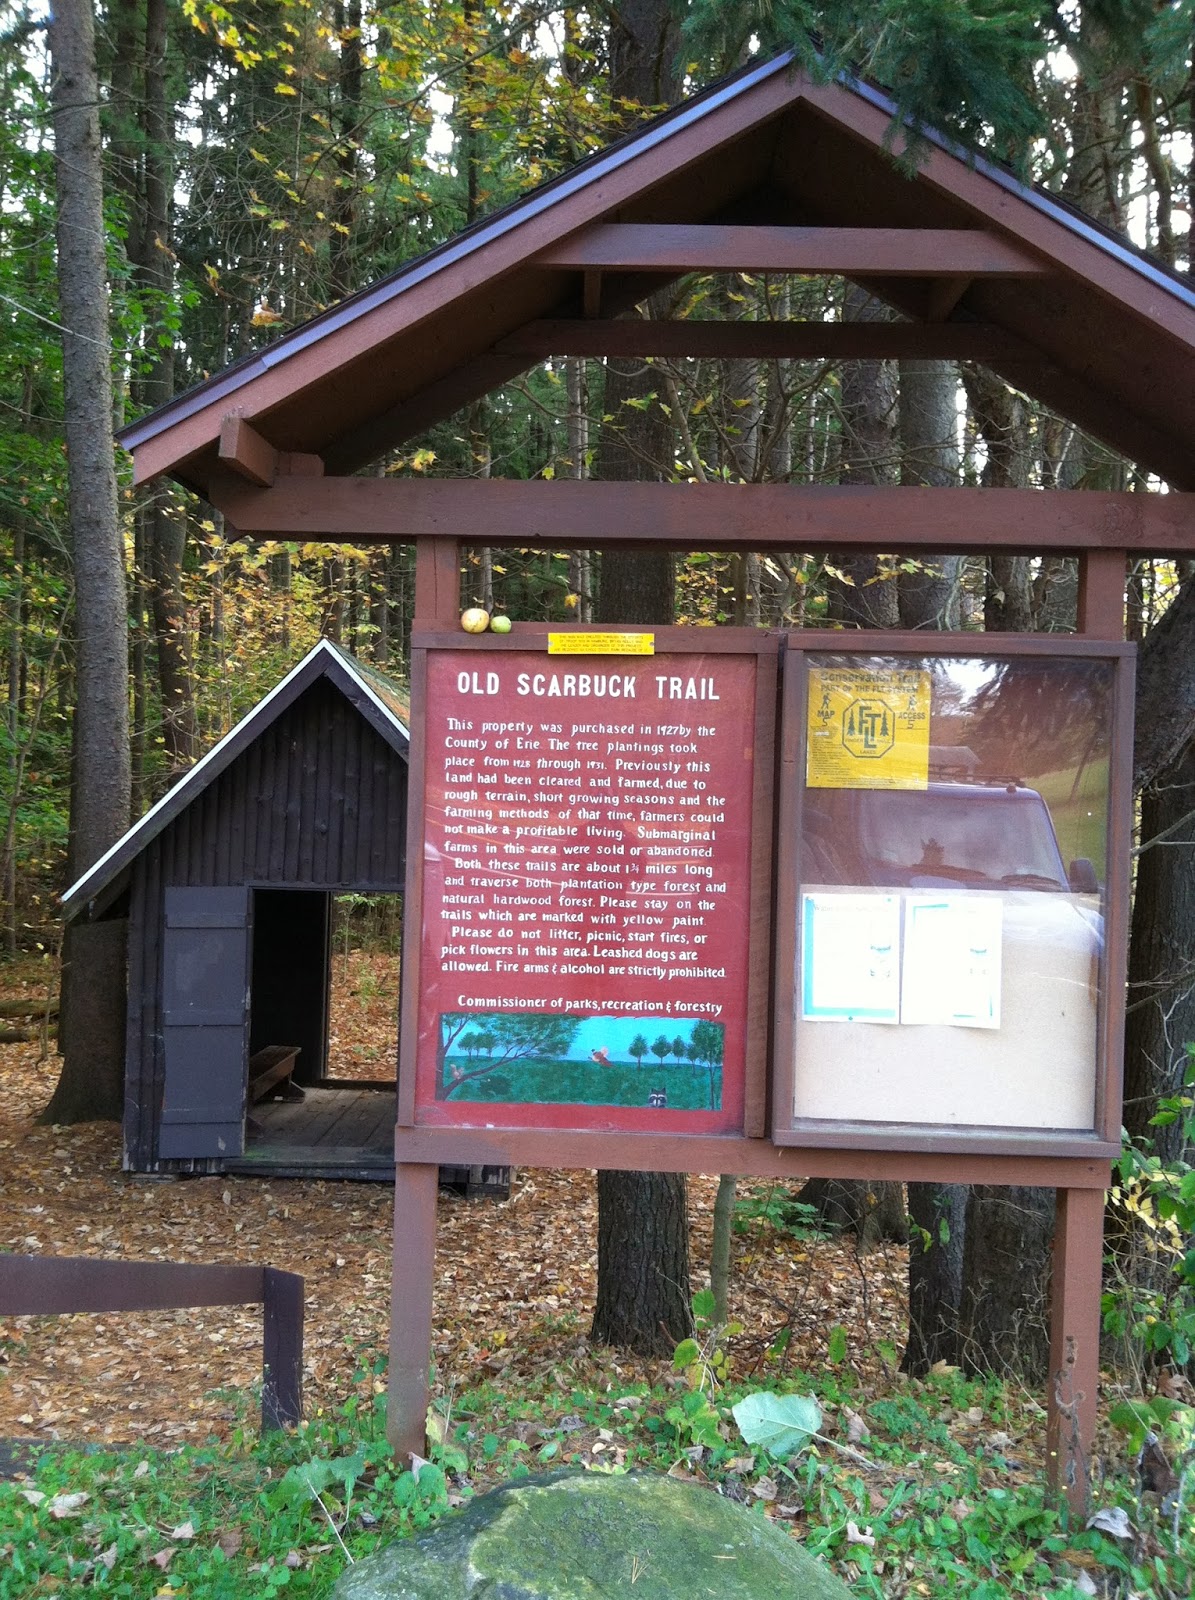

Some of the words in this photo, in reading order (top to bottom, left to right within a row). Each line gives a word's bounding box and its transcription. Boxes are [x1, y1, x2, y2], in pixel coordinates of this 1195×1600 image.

[458, 672, 499, 694] OLD
[517, 674, 635, 697] SCARBUCK
[656, 677, 719, 699] TRAIL
[817, 710, 835, 718] MAP
[898, 712, 926, 720] ACCESS
[447, 718, 473, 730] This
[482, 722, 533, 735] property
[541, 724, 562, 733] was
[571, 724, 634, 736] purchased
[640, 724, 651, 734] in
[698, 726, 715, 736] the
[445, 737, 487, 750] County
[495, 739, 509, 749] of
[548, 739, 569, 750] The
[576, 741, 598, 750] tree
[607, 741, 663, 755] plantings
[670, 743, 697, 753] took
[445, 756, 475, 769] place
[484, 756, 509, 766] from
[537, 758, 580, 771] through
[616, 759, 681, 773] Previously
[686, 762, 710, 772] this
[446, 772, 472, 782] land
[478, 773, 497, 783] had
[505, 774, 531, 784] been
[539, 776, 581, 787] cleared
[590, 777, 610, 786] and
[618, 777, 663, 789] farmed,
[666, 779, 687, 788] due
[693, 780, 706, 789] to
[445, 790, 477, 802] rough
[485, 792, 530, 803] terrain,
[534, 792, 563, 802] short
[569, 795, 619, 806] growing
[624, 795, 674, 804] seasons
[680, 795, 700, 805] and
[707, 796, 725, 806] the
[444, 806, 492, 820] farming
[499, 809, 549, 818] methods
[558, 809, 571, 819] of
[578, 808, 600, 819] that
[607, 811, 635, 821] time,
[640, 811, 684, 821] farmers
[691, 813, 724, 822] could
[445, 825, 463, 833] not
[467, 824, 498, 834] make
[502, 826, 510, 834] a
[516, 825, 577, 839] profitable
[638, 826, 715, 843] Submarginal
[444, 841, 477, 852] farms
[486, 843, 497, 853] in
[504, 843, 524, 853] this
[531, 846, 556, 854] area
[563, 846, 590, 854] were
[597, 845, 624, 854] sold
[630, 847, 643, 855] or
[453, 858, 482, 869] Both
[488, 859, 520, 870] these
[526, 861, 556, 871] trails
[562, 863, 580, 871] are
[586, 862, 620, 873] about
[646, 863, 676, 873] miles
[685, 864, 712, 878] long
[445, 876, 464, 885] and
[471, 878, 518, 887] traverse
[524, 877, 554, 888] both
[558, 879, 622, 893] plantation
[631, 881, 656, 893] type
[664, 881, 700, 892] forest
[706, 883, 726, 892] and
[442, 894, 484, 904] natural
[494, 894, 551, 905] hardwood
[600, 896, 637, 908] Please
[645, 900, 668, 911] stay
[677, 901, 691, 909] on
[698, 900, 715, 910] the
[441, 910, 471, 920] trails
[479, 909, 512, 921] which
[518, 913, 536, 921] are
[542, 913, 583, 922] marked
[591, 914, 616, 923] with
[623, 915, 663, 927] yellow
[452, 926, 492, 937] Please
[498, 928, 513, 937] do
[521, 930, 541, 938] not
[550, 929, 581, 941] litter,
[587, 931, 625, 943] picnic,
[628, 932, 654, 941] start
[660, 932, 689, 944] fires,
[694, 935, 707, 943] or
[441, 944, 465, 958] pick
[470, 944, 513, 955] flowers
[518, 944, 528, 955] in
[535, 946, 557, 956] this
[563, 948, 591, 957] area.
[594, 945, 642, 958] Leashed
[646, 949, 676, 962] dogs
[679, 951, 697, 960] are
[442, 961, 493, 971] allowed.
[496, 960, 518, 971] Fire
[524, 964, 549, 973] arms
[560, 964, 604, 974] alcohol
[628, 966, 666, 980] strictly
[458, 995, 547, 1007] Commissioner
[551, 998, 563, 1007] of
[565, 999, 600, 1012] parks,
[602, 1000, 663, 1010] recreation
[674, 1001, 722, 1016] forestry
